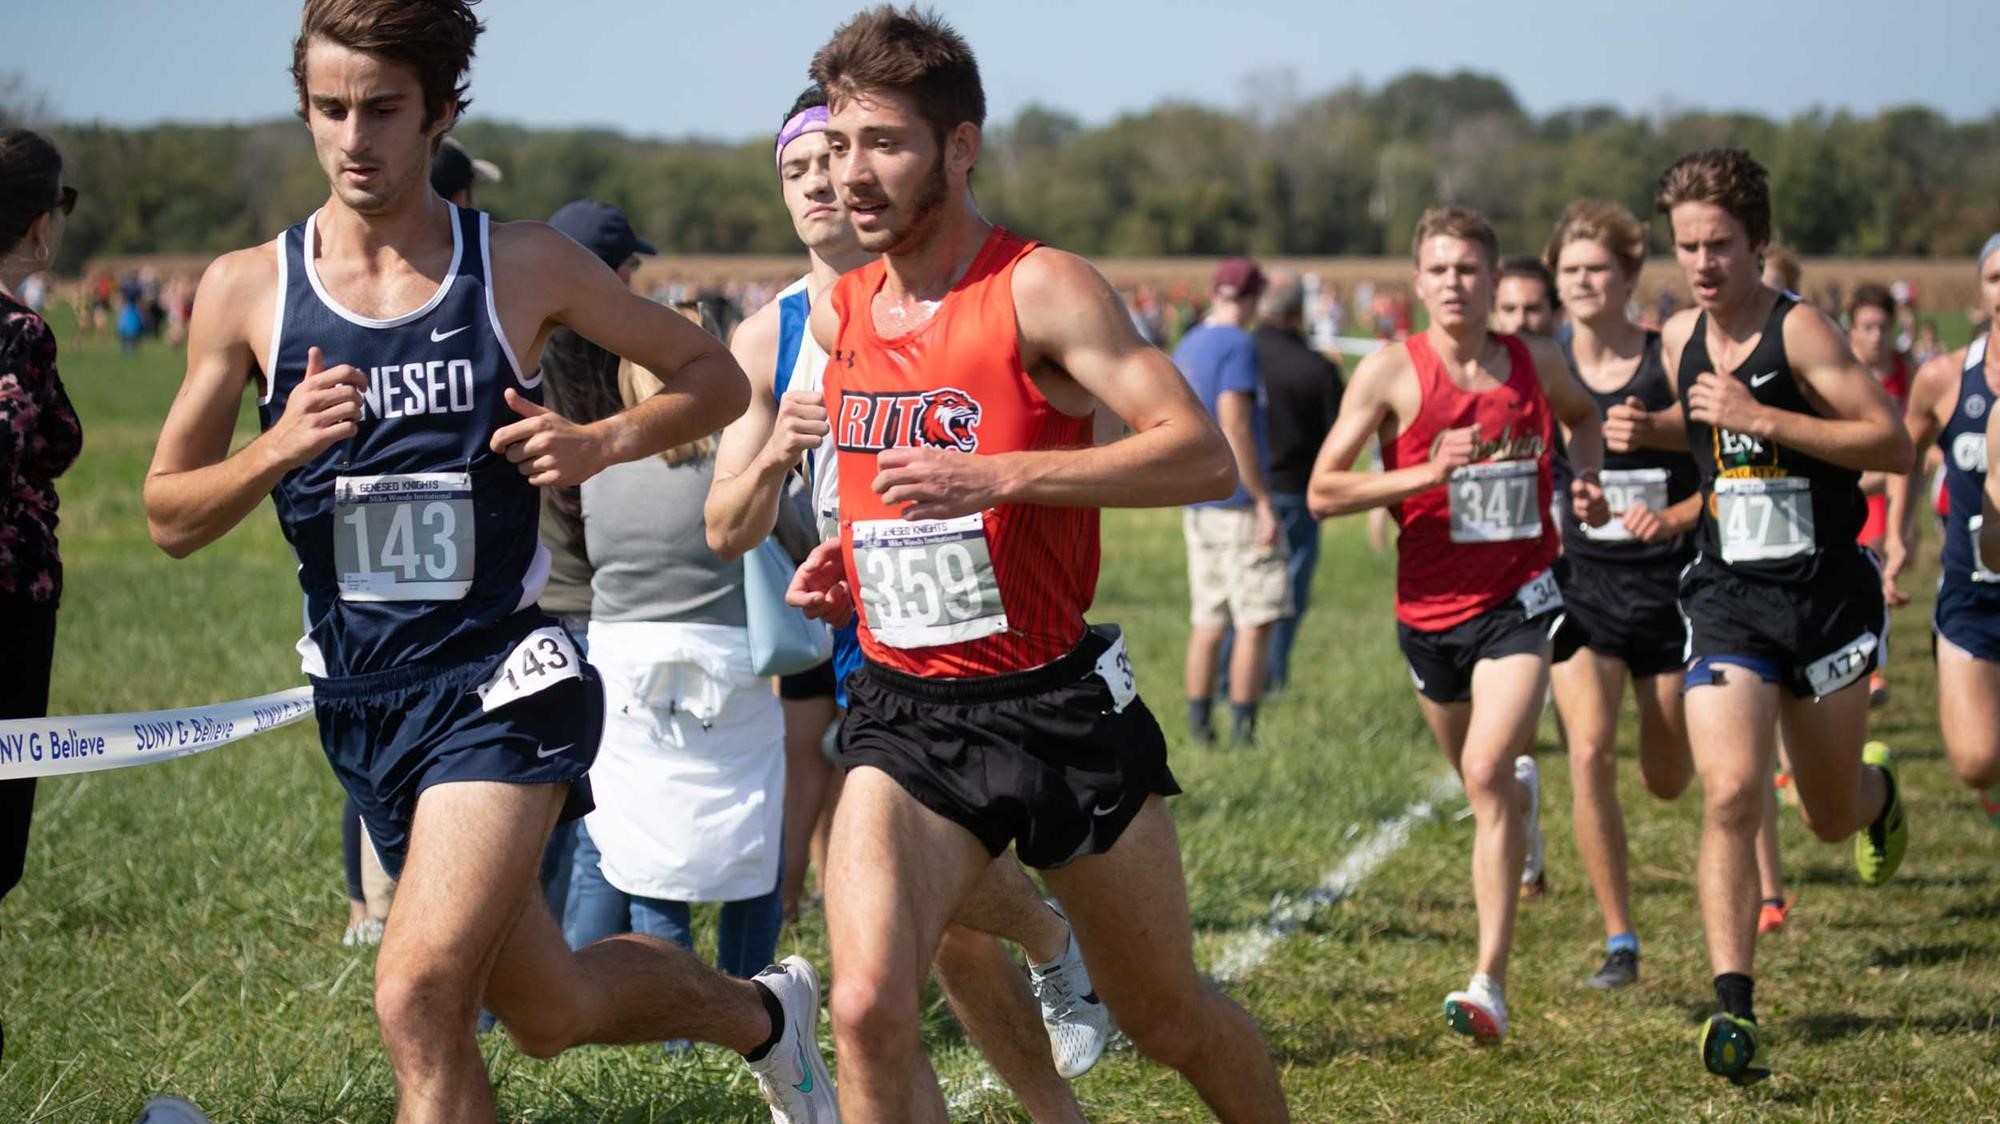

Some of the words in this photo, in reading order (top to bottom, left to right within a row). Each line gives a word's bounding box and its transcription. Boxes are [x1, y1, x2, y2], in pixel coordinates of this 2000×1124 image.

[837, 390, 930, 451] RIT
[401, 479, 440, 491] KNIGHTS
[1459, 478, 1531, 529] 347
[343, 502, 458, 580] 143
[1726, 494, 1801, 546] 471
[866, 543, 983, 628] 359
[502, 637, 569, 691] 143
[29, 732, 43, 762] G
[49, 727, 105, 760] Believe
[133, 720, 174, 751] SUNY
[176, 719, 189, 746] G
[189, 716, 234, 744] Believe
